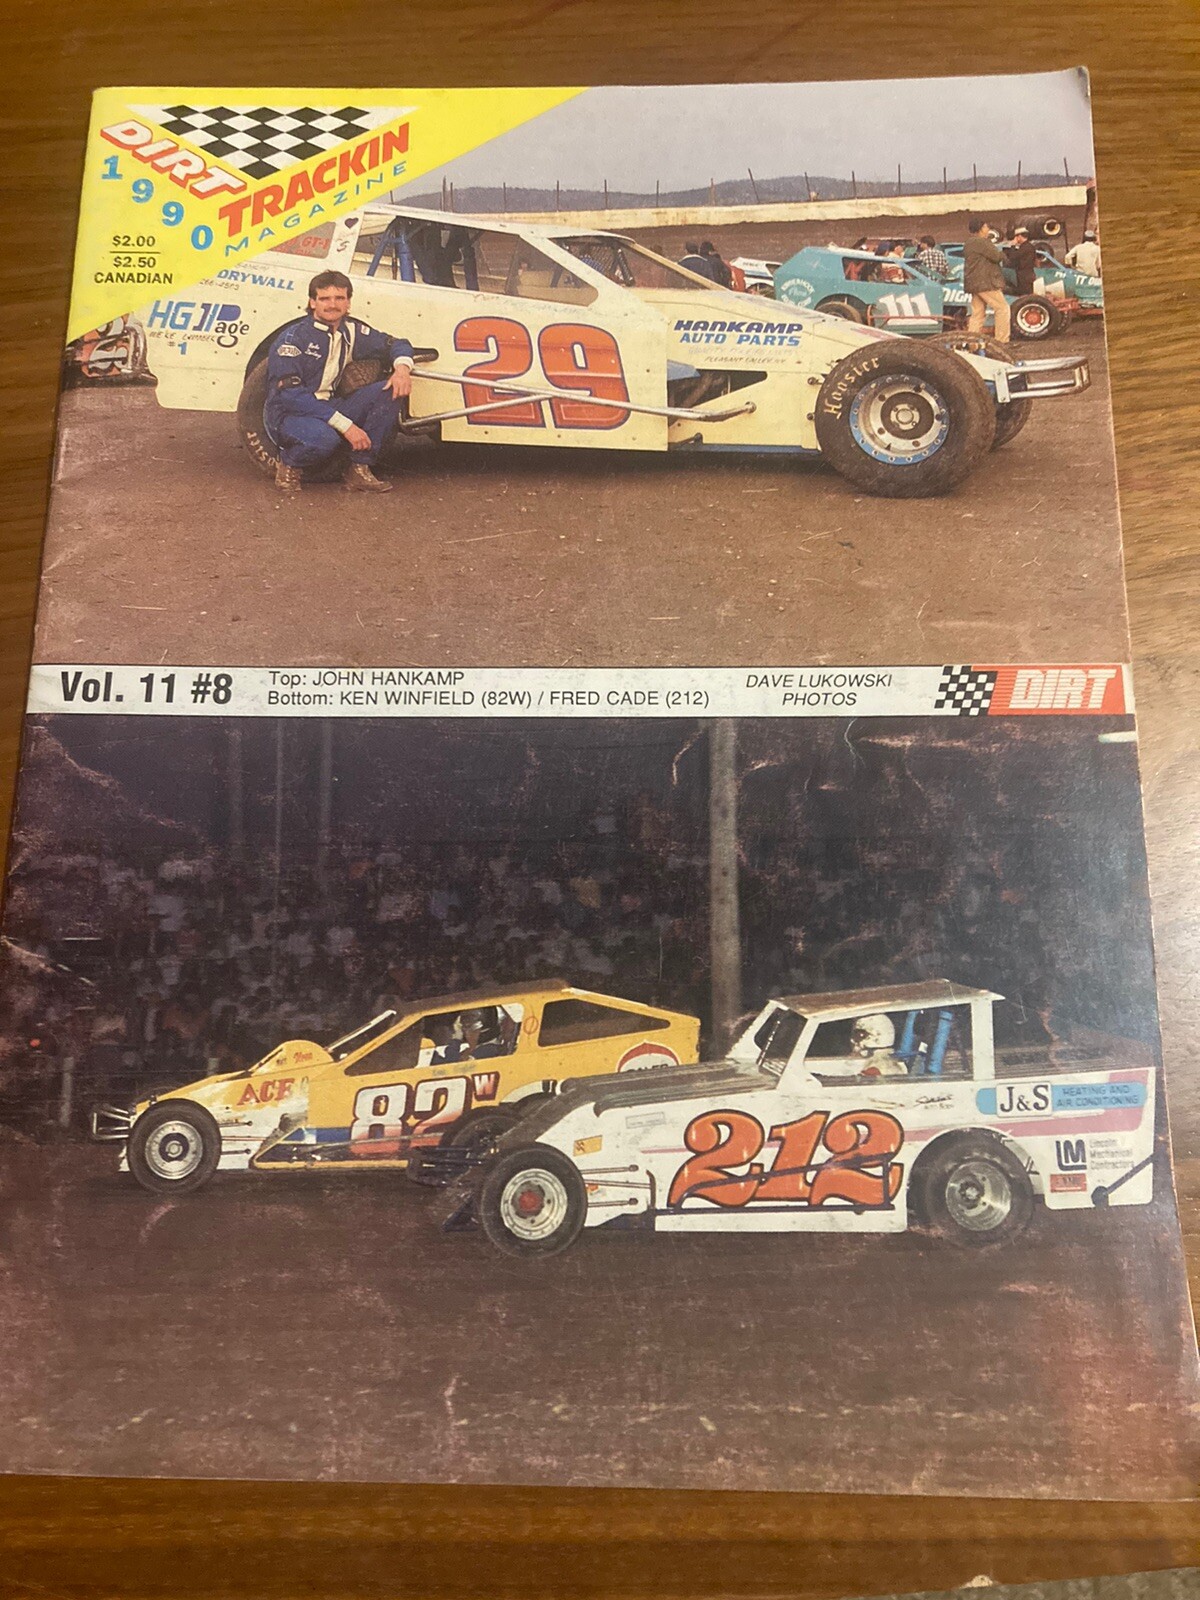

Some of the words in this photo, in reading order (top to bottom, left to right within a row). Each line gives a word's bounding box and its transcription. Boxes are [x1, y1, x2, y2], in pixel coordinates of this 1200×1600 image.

[100, 119, 247, 200] DIRT
[218, 122, 410, 238] TRACKIN
[224, 160, 408, 257] MAGAZINE
[112, 235, 156, 248] $2.00
[113, 256, 157, 269] $2.50
[94, 271, 173, 285] CANADIAN
[217, 269, 294, 291] DRYWALL
[674, 320, 803, 334] HANKAMP
[680, 333, 727, 344] AUTO
[737, 334, 801, 346] PARTS
[454, 316, 630, 430] 29
[823, 356, 880, 420] Hoosier
[62, 671, 124, 703] Vol.
[140, 673, 175, 703] 11
[190, 672, 233, 705] #8
[268, 671, 306, 688] Top:
[312, 671, 364, 686] JOHN
[371, 671, 465, 686] HANKAMP
[746, 674, 794, 688] DAVE
[798, 673, 892, 688] LUKOWSKI
[1009, 668, 1117, 710] DIRT
[268, 691, 333, 706] Bottom:
[340, 691, 378, 706] KEN
[384, 691, 475, 706] WINFIELD
[481, 691, 532, 709] (82W)
[537, 691, 544, 706] /
[550, 691, 600, 706] FRED
[606, 691, 659, 706] CADE
[665, 691, 709, 709] (212)
[782, 692, 857, 706] PHOTOS
[236, 1078, 296, 1106] ACE
[1000, 1084, 1050, 1112] J&S
[1056, 1098, 1073, 1107] AIR
[1076, 1095, 1139, 1107] CONDITIONING
[1062, 1086, 1106, 1097] HEATING
[1109, 1085, 1130, 1094] AND
[668, 1109, 904, 1208] 212
[1056, 1139, 1087, 1171] LM
